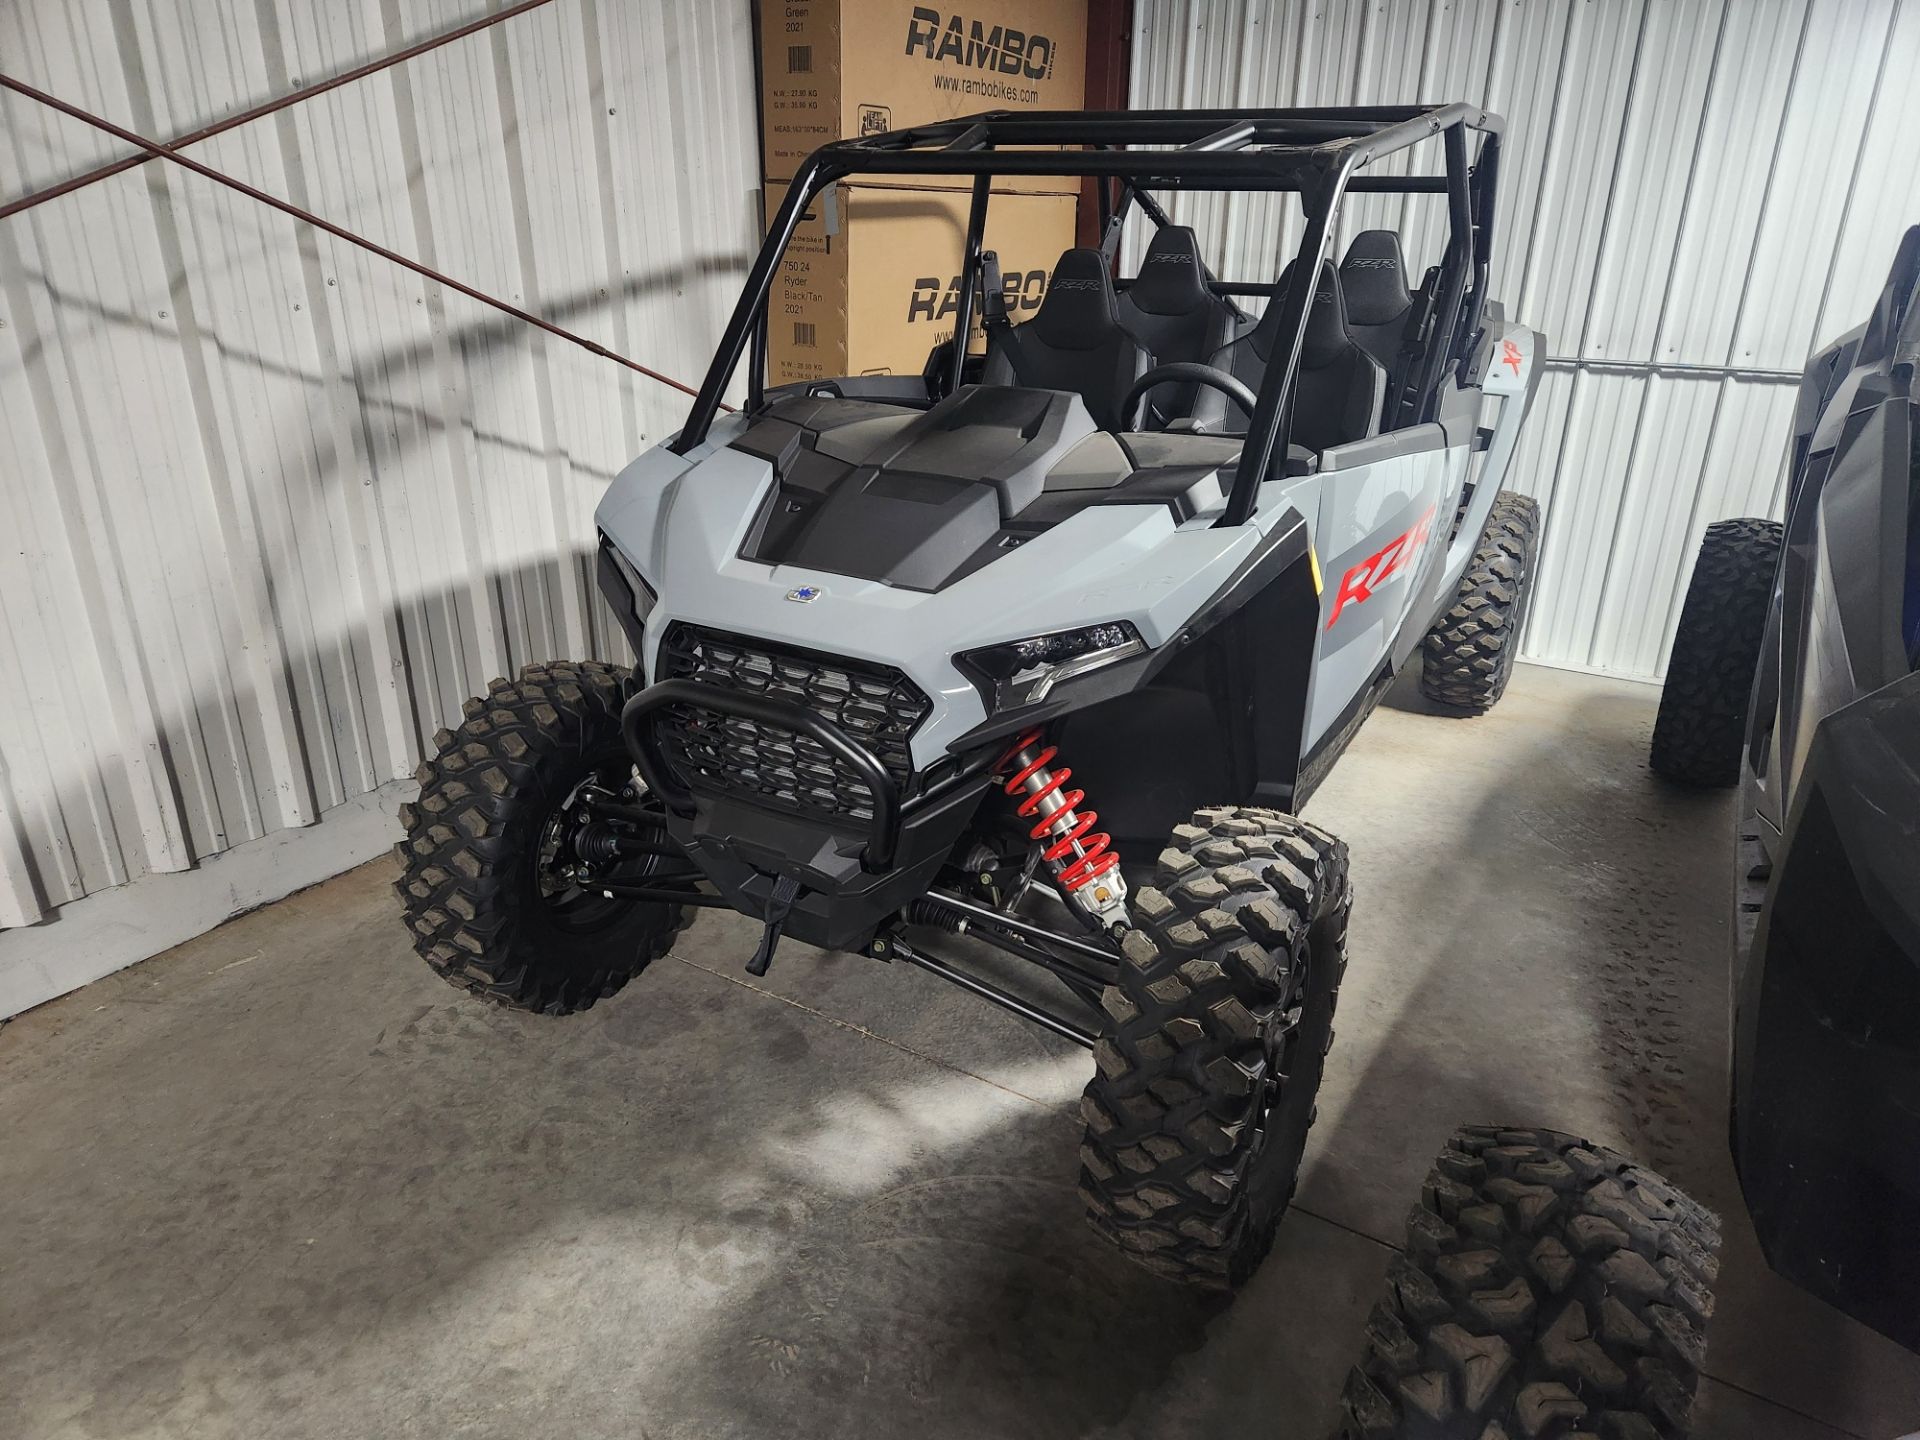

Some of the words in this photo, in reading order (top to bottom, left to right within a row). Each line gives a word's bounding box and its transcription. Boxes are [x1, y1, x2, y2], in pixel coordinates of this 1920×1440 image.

[786, 7, 808, 17] Green
[786, 22, 804, 32] 2021
[905, 6, 1051, 80] RAMBO
[808, 89, 818, 97] KG
[933, 74, 1039, 104] www.rambobikes.com
[1149, 252, 1192, 264] RZR
[1348, 257, 1397, 270] RZR
[784, 261, 798, 271] 750
[800, 262, 810, 271] 24
[784, 275, 808, 287] Ryder
[1053, 278, 1101, 291] RZR
[784, 290, 823, 302] Black/Tan
[907, 270, 1046, 323] RABO
[785, 304, 804, 314] 2021
